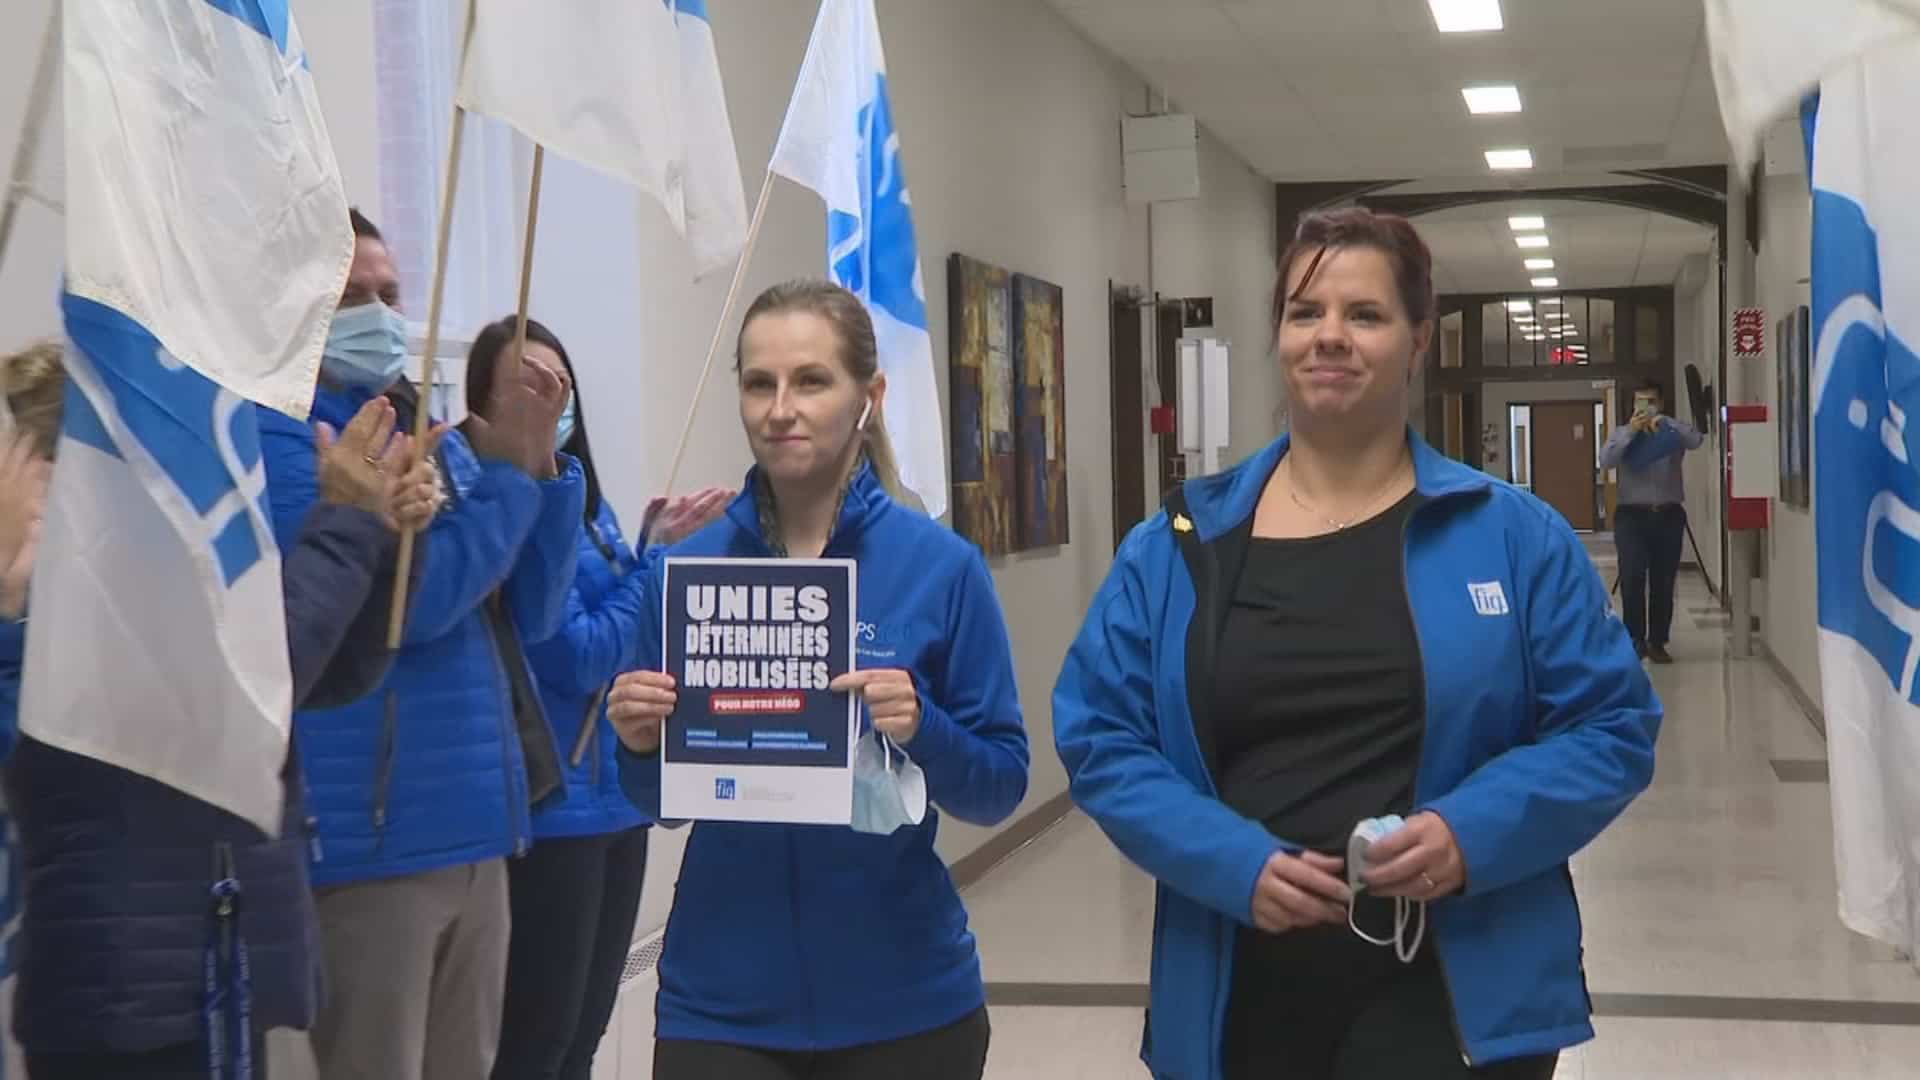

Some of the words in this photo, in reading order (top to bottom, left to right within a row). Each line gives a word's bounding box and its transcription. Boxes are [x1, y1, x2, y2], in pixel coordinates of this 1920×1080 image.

[686, 585, 829, 622] UNIES
[685, 620, 830, 657] DÉTERMINÉES
[685, 657, 830, 690] MOBILISÉES
[714, 698, 741, 711] POUR
[742, 698, 773, 710] NOTRE
